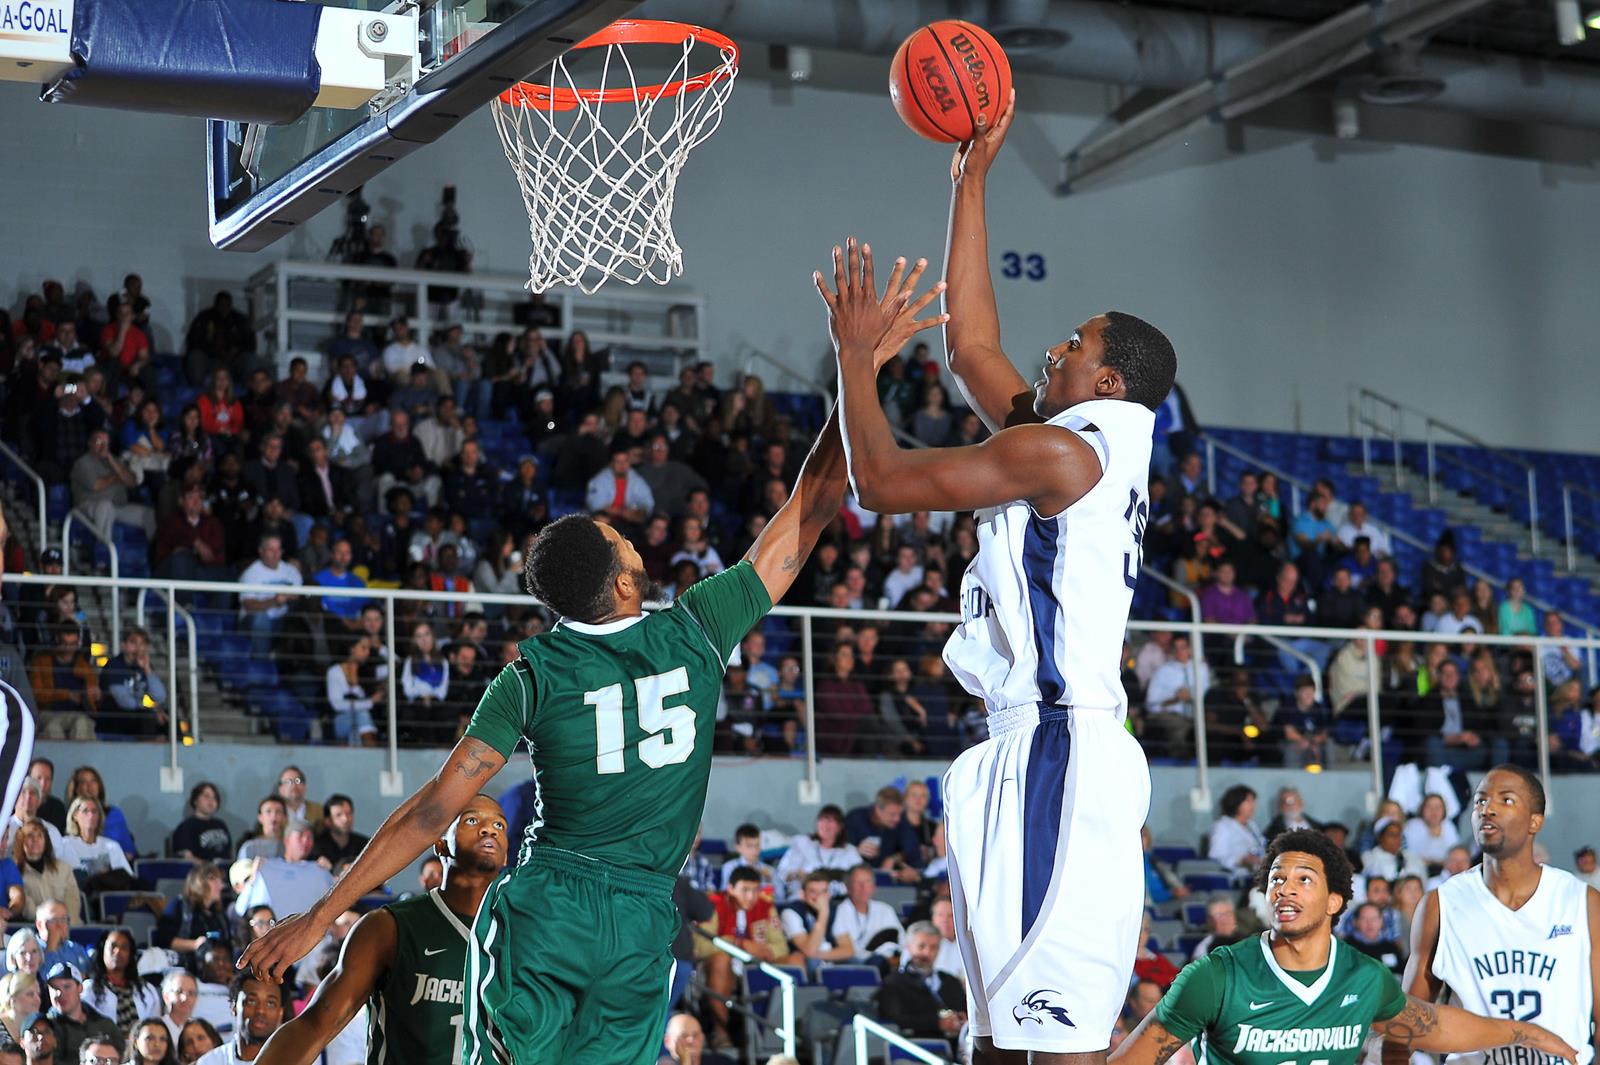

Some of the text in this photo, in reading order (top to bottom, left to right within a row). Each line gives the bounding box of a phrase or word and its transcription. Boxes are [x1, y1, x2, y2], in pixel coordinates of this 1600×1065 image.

[0, 1, 68, 33] A-GOAL
[919, 56, 957, 114] NCAA
[950, 33, 990, 110] Wilson
[1002, 252, 1046, 281] 33
[584, 666, 696, 774] 15
[1473, 950, 1557, 981] NORTH
[1490, 990, 1542, 1022] 32
[1233, 1024, 1362, 1054] JACKSONVILLE
